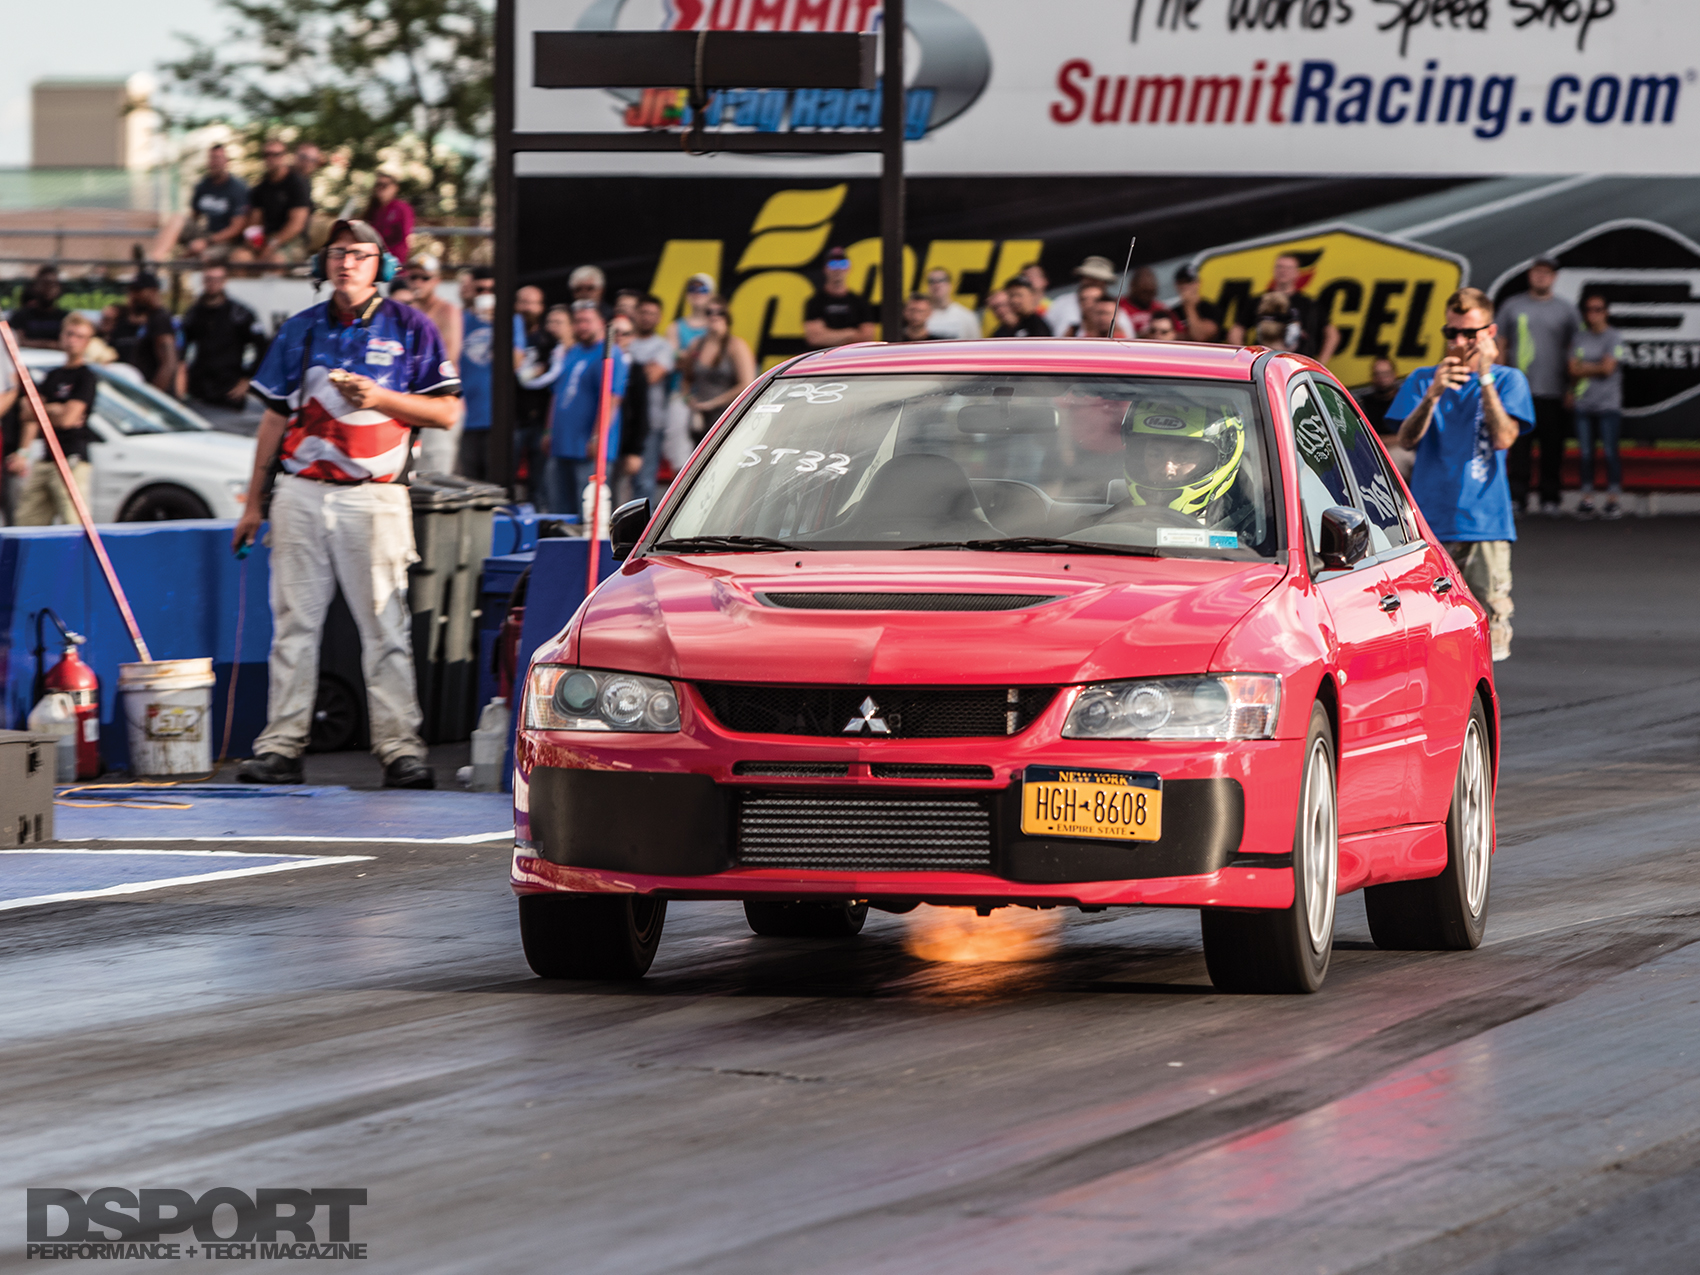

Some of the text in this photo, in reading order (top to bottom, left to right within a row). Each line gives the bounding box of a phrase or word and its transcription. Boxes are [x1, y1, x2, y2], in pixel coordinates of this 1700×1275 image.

[1214, 277, 1436, 358] ACEL
[1622, 343, 1700, 369] ASKET
[1058, 771, 1129, 786] NEW YORK
[1056, 823, 1128, 836] EMPIRE STATE
